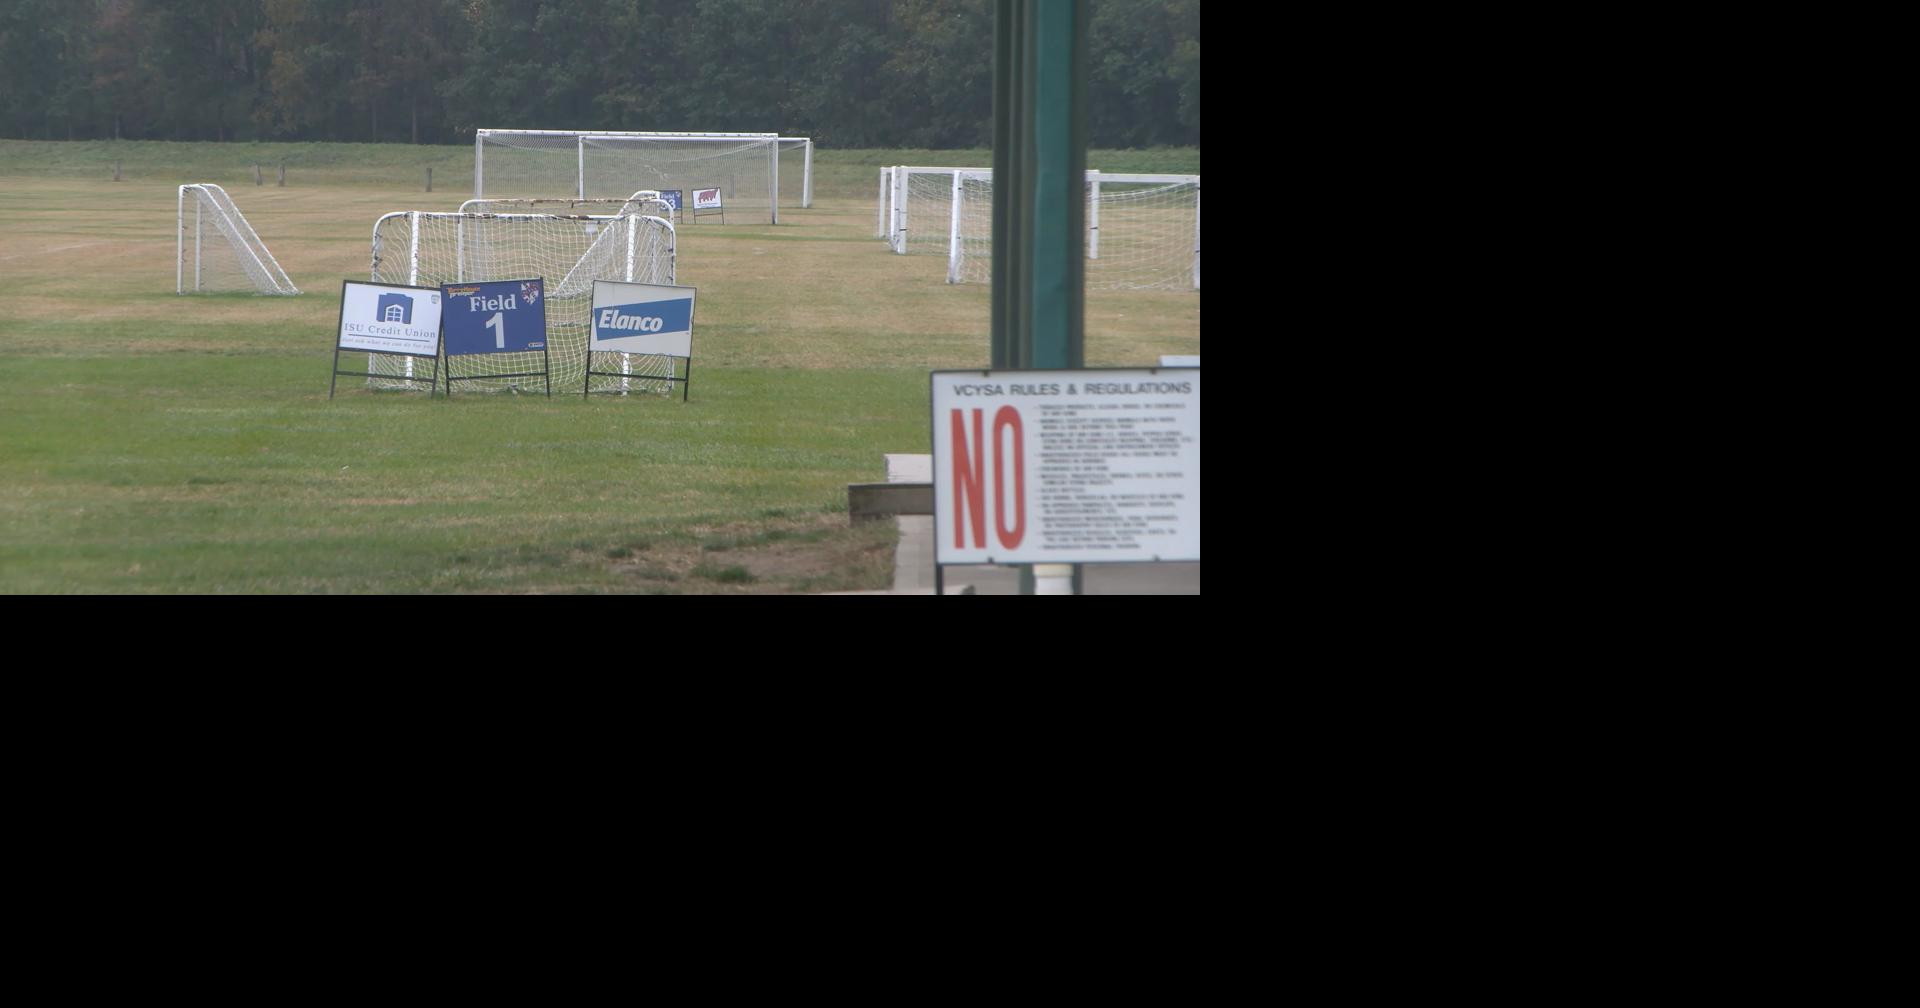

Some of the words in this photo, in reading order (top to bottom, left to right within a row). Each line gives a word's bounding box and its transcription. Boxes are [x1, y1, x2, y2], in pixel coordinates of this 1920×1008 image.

[469, 293, 517, 313] Field
[344, 322, 364, 333] ISU
[368, 325, 401, 336] Credit
[405, 328, 437, 339] Union
[485, 311, 505, 349] 1
[598, 308, 664, 332] Elanco
[953, 384, 1005, 397] VCYSA
[1009, 383, 1061, 397] RULES
[1066, 383, 1078, 396] &
[1083, 381, 1193, 396] REGULATIONS
[950, 404, 1027, 551] NO
